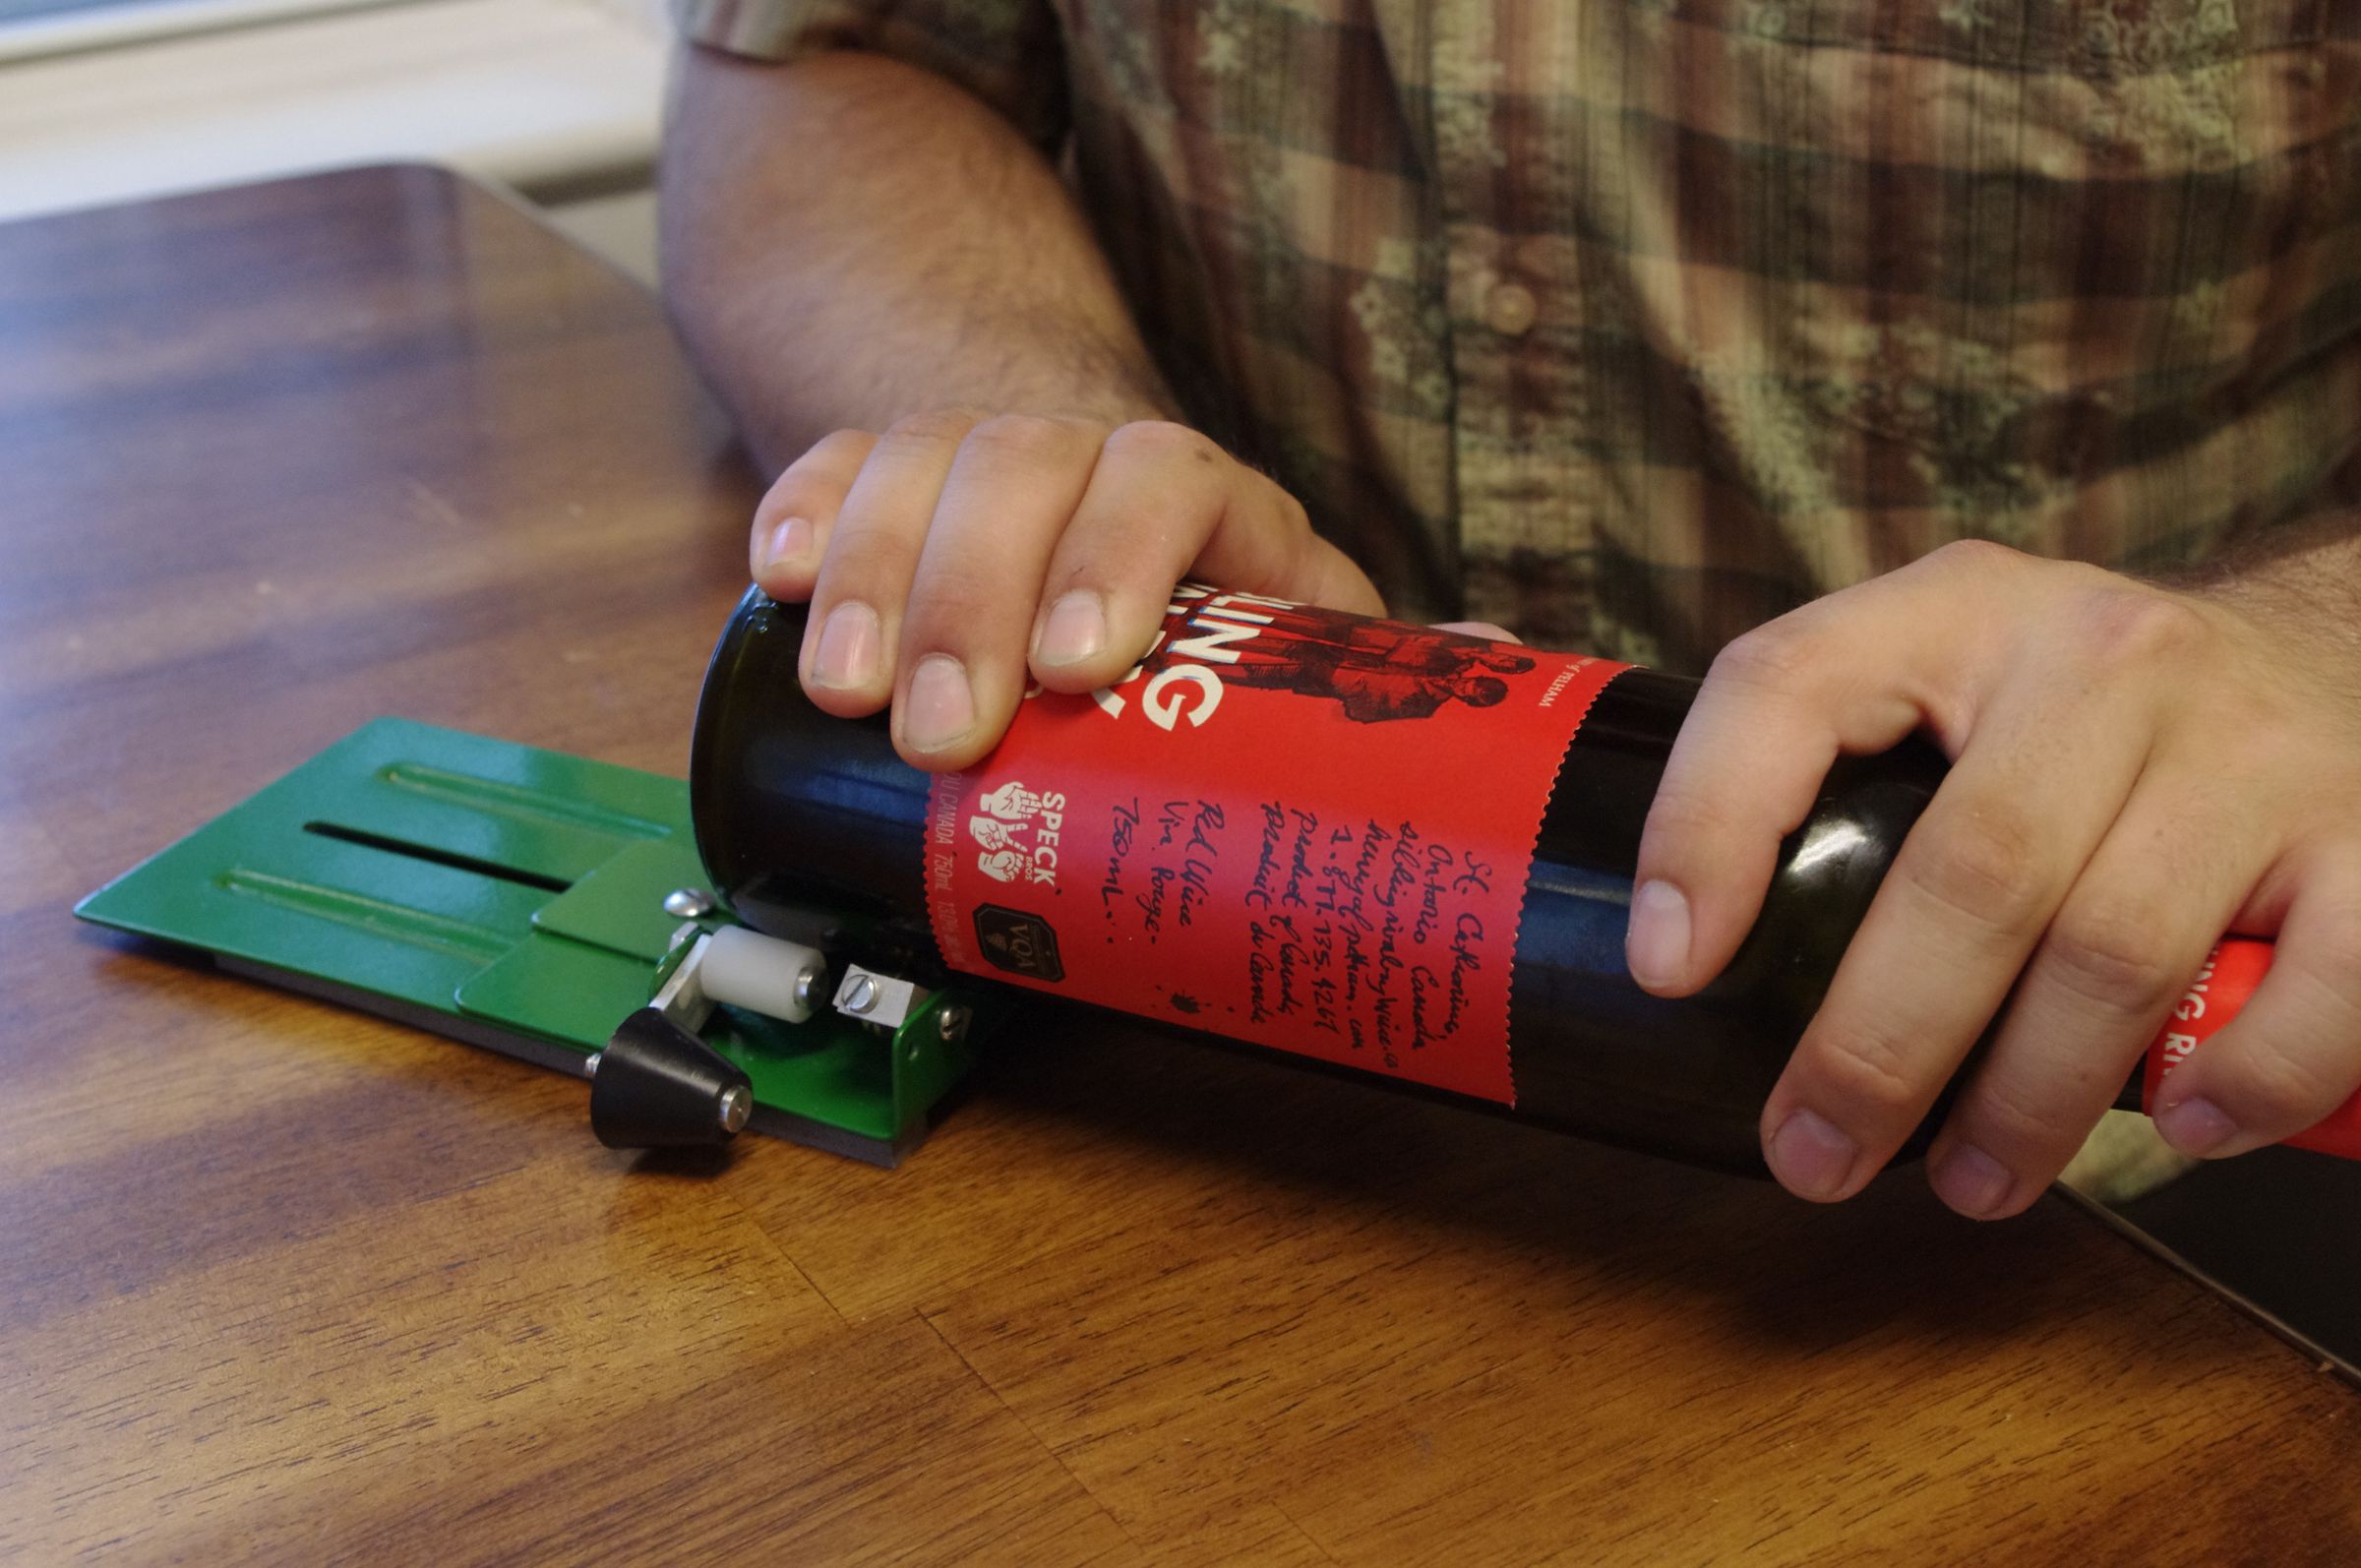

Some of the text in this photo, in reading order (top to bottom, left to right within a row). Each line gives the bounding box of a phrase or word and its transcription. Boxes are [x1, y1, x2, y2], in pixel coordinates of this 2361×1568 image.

[1142, 591, 1294, 731] LING
[1539, 671, 1575, 707] PELHAM
[936, 793, 959, 845] CANADA
[1034, 791, 1066, 886] SPECK
[1158, 802, 1189, 846] Vin
[1180, 800, 1225, 927] Red Wine
[1008, 923, 1037, 968] VQA
[1277, 942, 1310, 1016] Canada
[1411, 844, 1453, 1051] Ontario Canada
[1249, 951, 1274, 1024] Canada
[2164, 1033, 2197, 1076] RI
